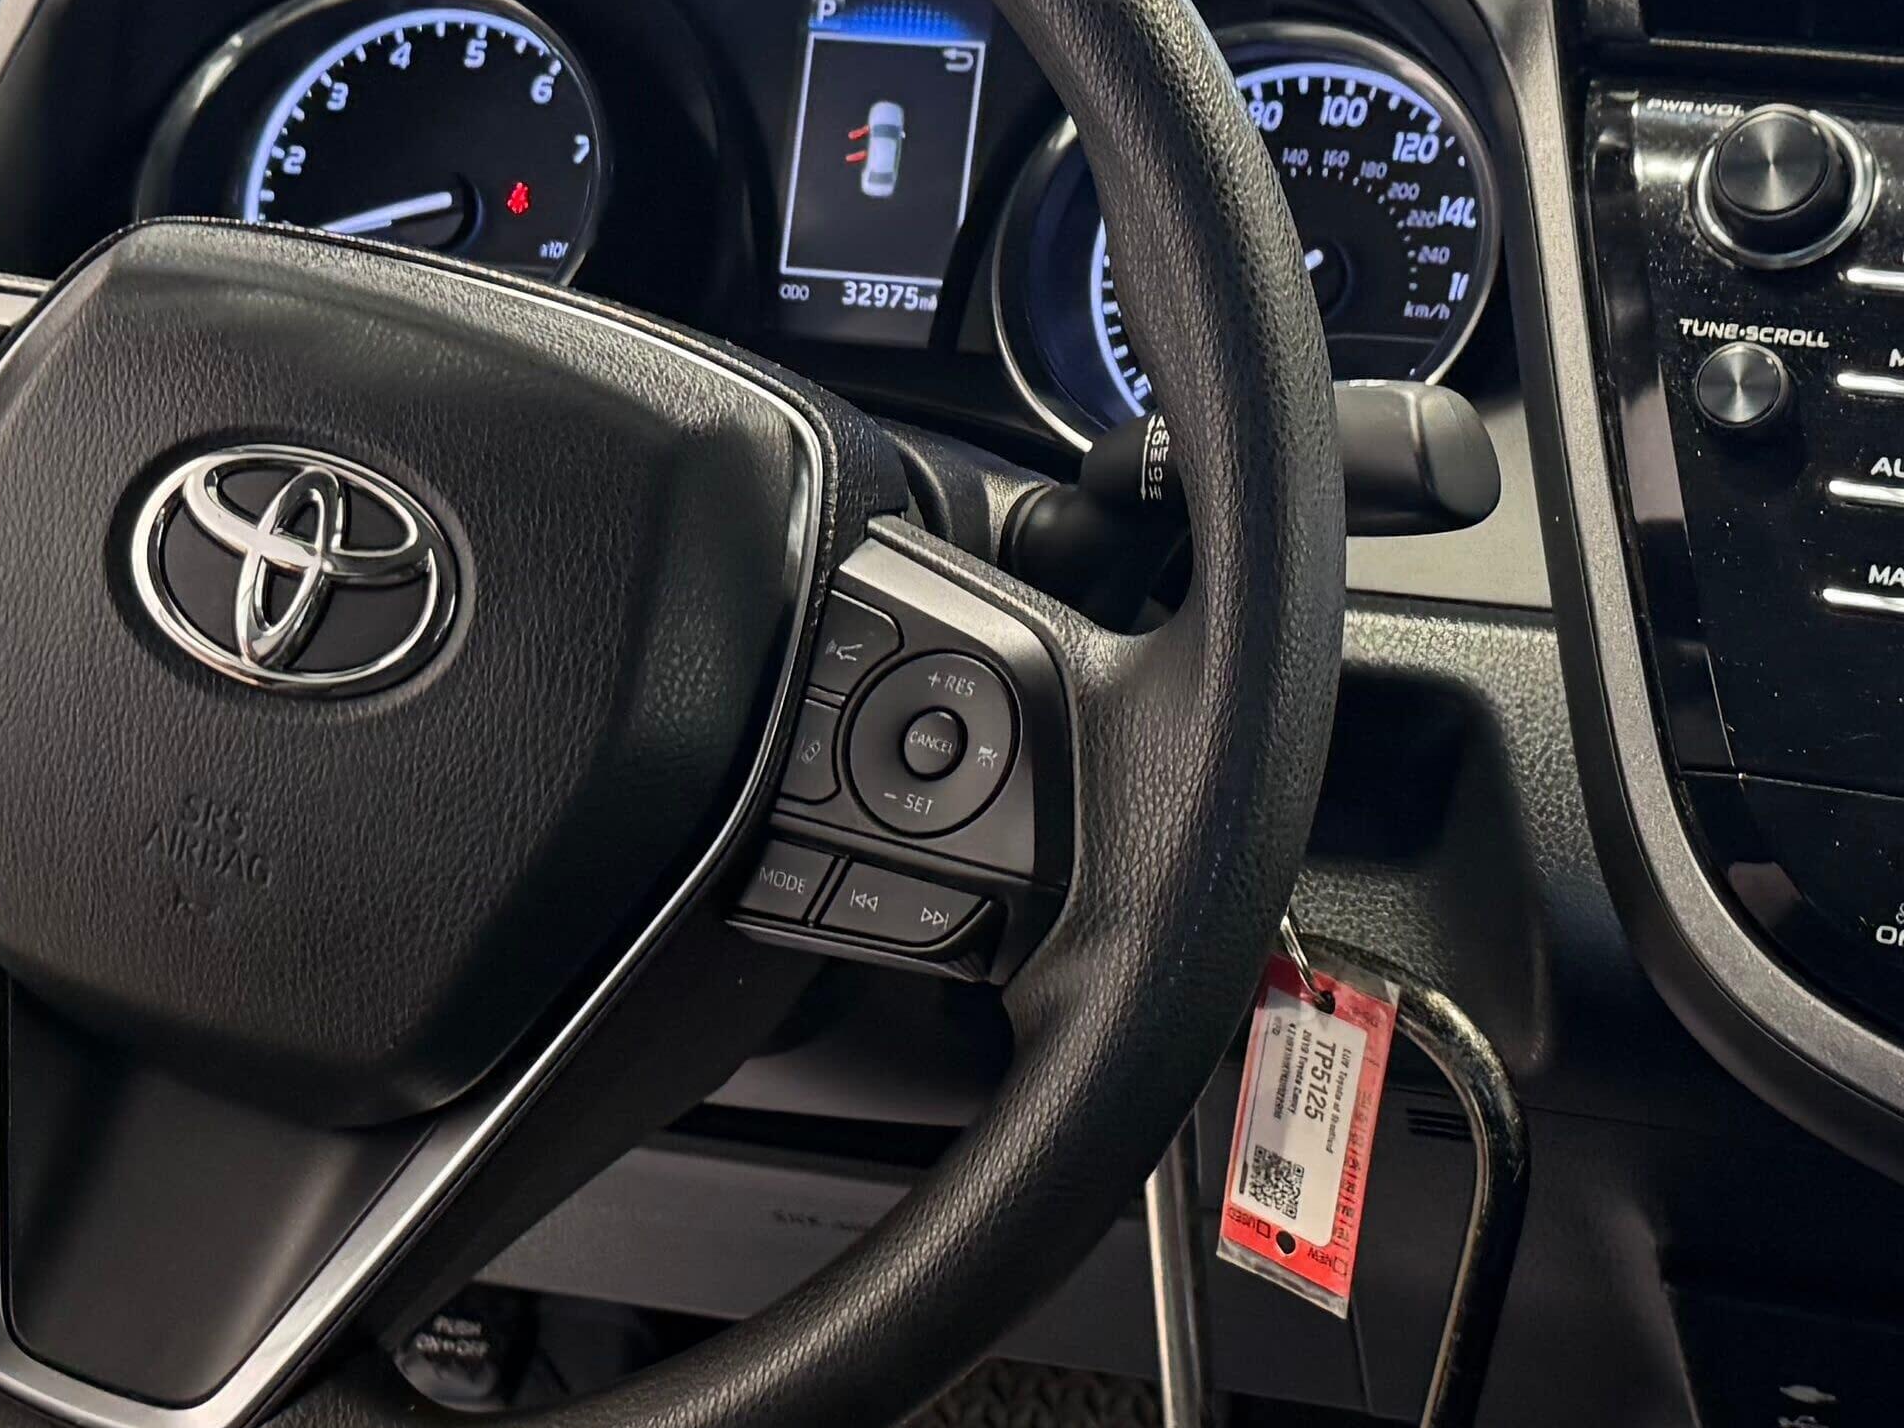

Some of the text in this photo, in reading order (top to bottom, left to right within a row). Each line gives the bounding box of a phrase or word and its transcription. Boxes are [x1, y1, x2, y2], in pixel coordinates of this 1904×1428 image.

[389, 39, 412, 69] 4
[465, 39, 487, 69] 5
[327, 81, 350, 112] 3
[530, 76, 554, 104] 6
[1320, 95, 1368, 128] 100
[284, 145, 306, 174] 2
[573, 134, 591, 164] 7
[1282, 147, 1309, 168] 140
[1323, 149, 1350, 169] 160
[1392, 131, 1439, 165] 120
[1360, 160, 1388, 180] 180
[1387, 181, 1420, 202] 200
[779, 283, 809, 302] ODO
[841, 279, 919, 311] 32975
[1403, 300, 1450, 320] km/h
[908, 729, 954, 756] CANCEL
[758, 865, 806, 895] MODE
[1303, 1036, 1336, 1124] TP5125
